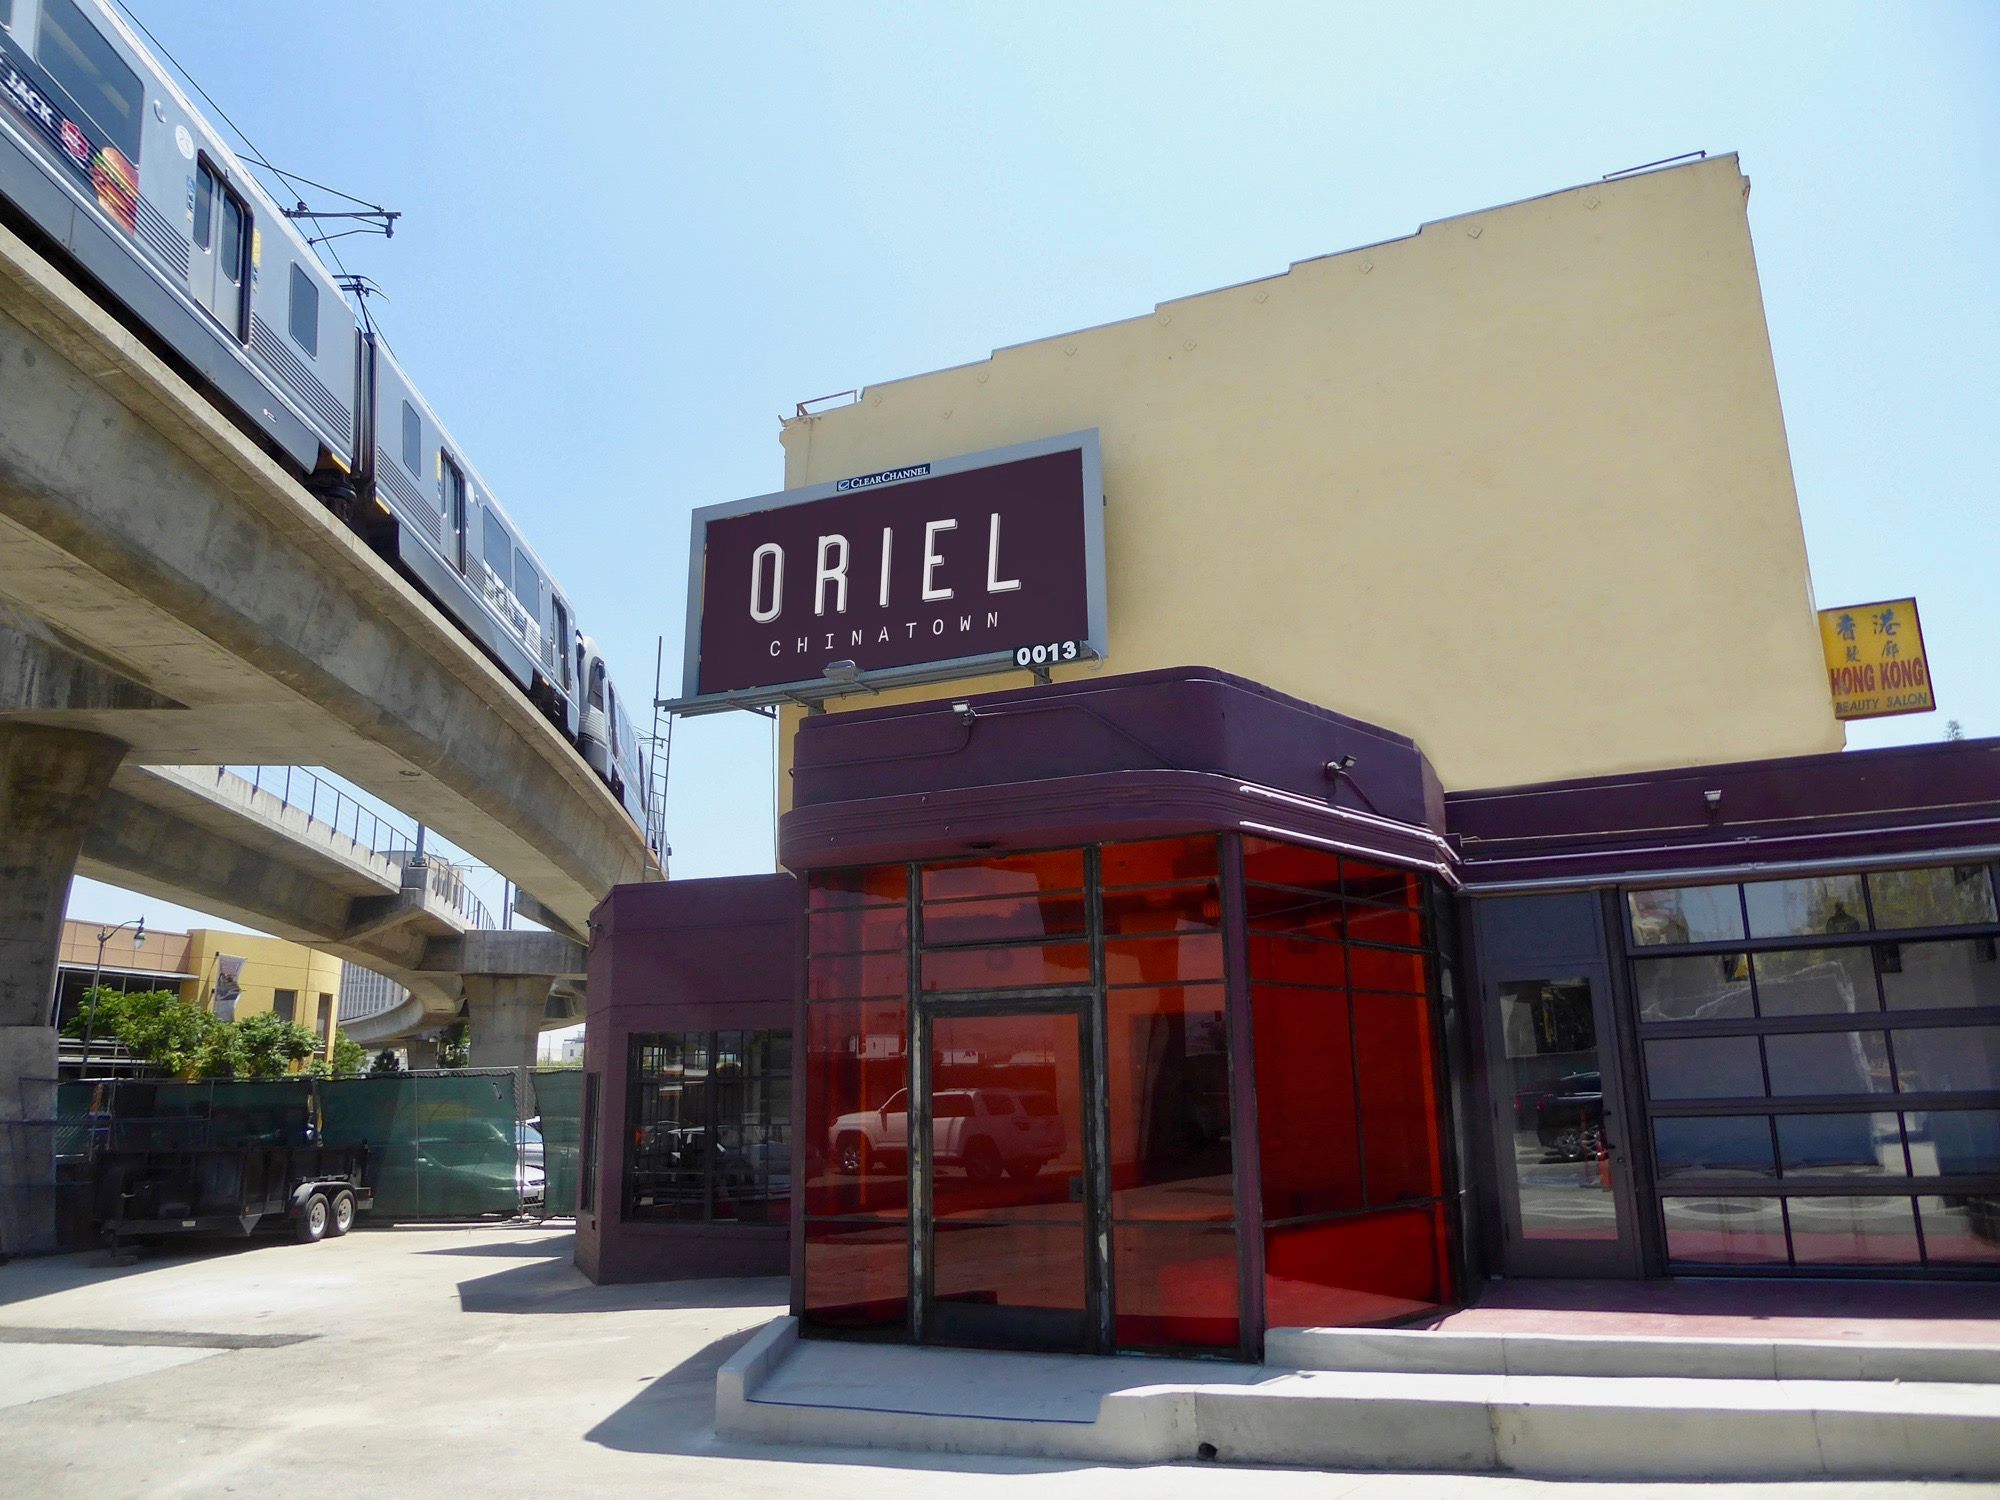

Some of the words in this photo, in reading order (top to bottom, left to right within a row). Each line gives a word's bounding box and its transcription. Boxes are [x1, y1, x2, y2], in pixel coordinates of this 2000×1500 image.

[750, 513, 1022, 624] ORIEL
[769, 611, 1000, 657] CHINATOWN
[1016, 641, 1077, 666] 0013
[1830, 664, 1875, 697] HONG
[1880, 656, 1925, 690] KONG
[1835, 698, 1880, 714] BEAUTY
[1887, 692, 1928, 709] SALON
